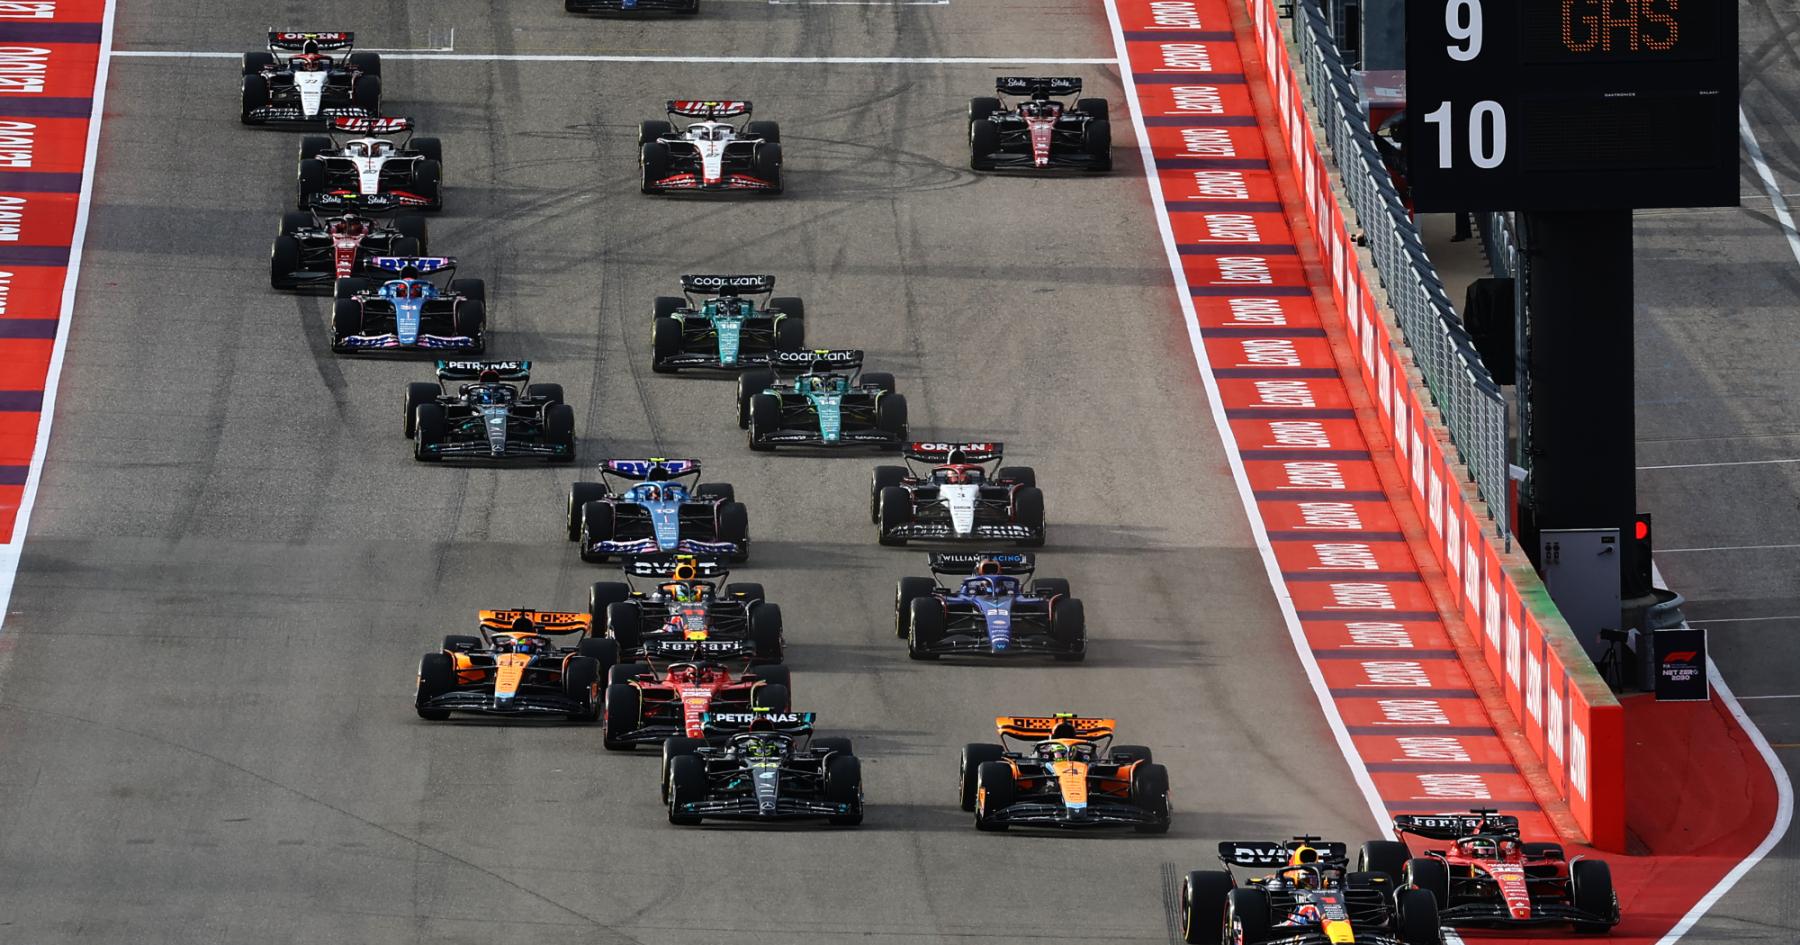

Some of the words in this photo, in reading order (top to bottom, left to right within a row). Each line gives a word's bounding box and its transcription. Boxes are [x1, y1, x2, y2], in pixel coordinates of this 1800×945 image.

[1144, 1, 1201, 29] Lenovo
[1562, 0, 1679, 51] GAS
[1445, 0, 1483, 61] 9
[1153, 43, 1212, 72] Lenovo
[1164, 86, 1224, 114] Lenovo
[1176, 128, 1235, 157] Lenovo
[1424, 100, 1507, 169] 10
[1187, 171, 1248, 199] Lenovo
[1199, 214, 1260, 242] Lenovo
[1210, 256, 1272, 284] Lenovo
[1222, 298, 1286, 325] Lenovo
[1235, 339, 1301, 366] Lenovo
[1249, 380, 1315, 407] Lenovo
[1263, 421, 1330, 447] Lenovo
[1276, 462, 1345, 489] Lenovo
[1292, 503, 1362, 529] Lenovo
[1307, 543, 1379, 570] Lenovo
[1323, 583, 1395, 609] Lenovo
[1340, 622, 1413, 648] Lenovo
[1356, 661, 1431, 687] Lenovo
[716, 713, 798, 723] PETRNAS
[1372, 700, 1449, 725] Lenovo
[1392, 737, 1471, 762] Lenovo
[1410, 774, 1491, 799] Lenovo
